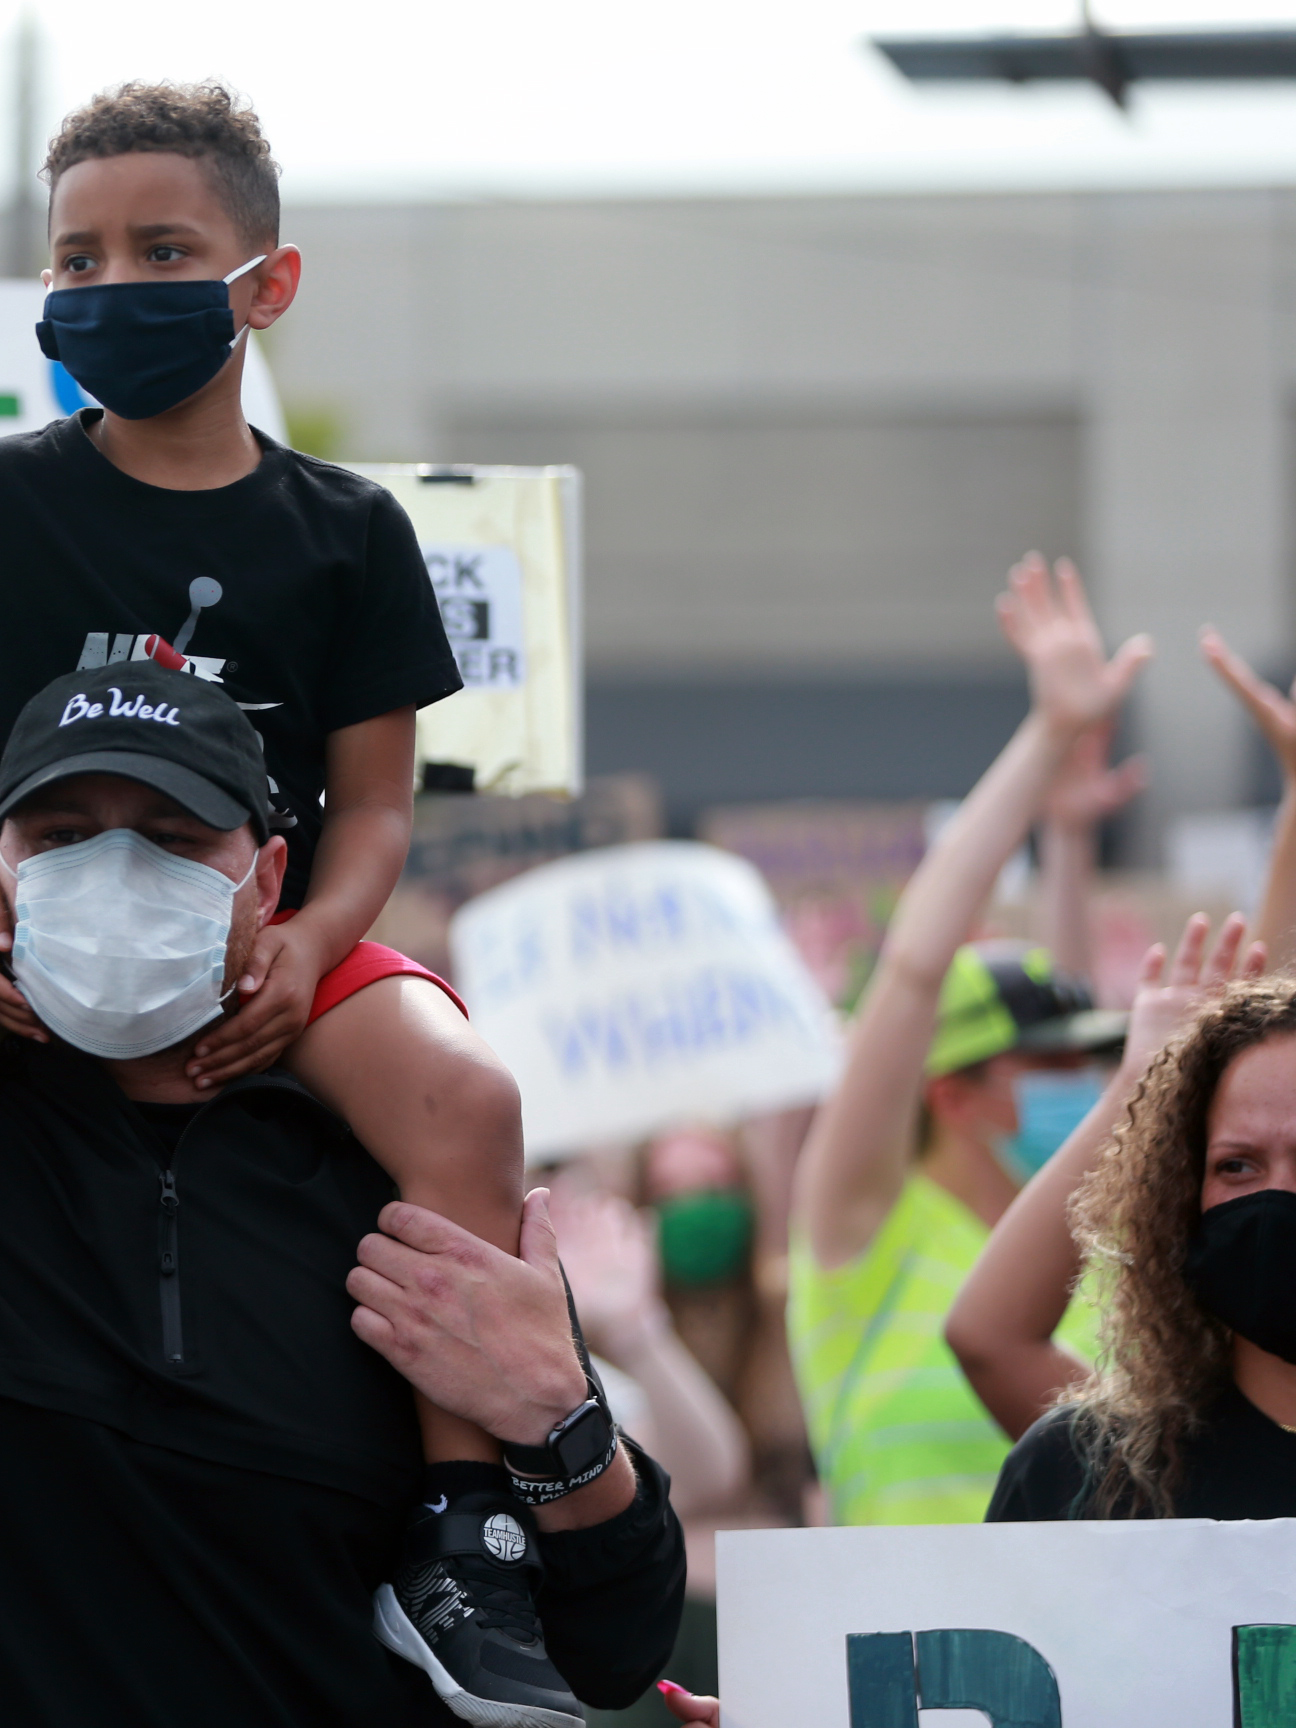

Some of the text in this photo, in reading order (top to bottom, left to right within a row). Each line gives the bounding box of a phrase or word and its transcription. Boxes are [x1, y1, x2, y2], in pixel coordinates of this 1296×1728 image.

[58, 686, 181, 728] Be Well
[511, 1463, 604, 1493] BETTER MIND
